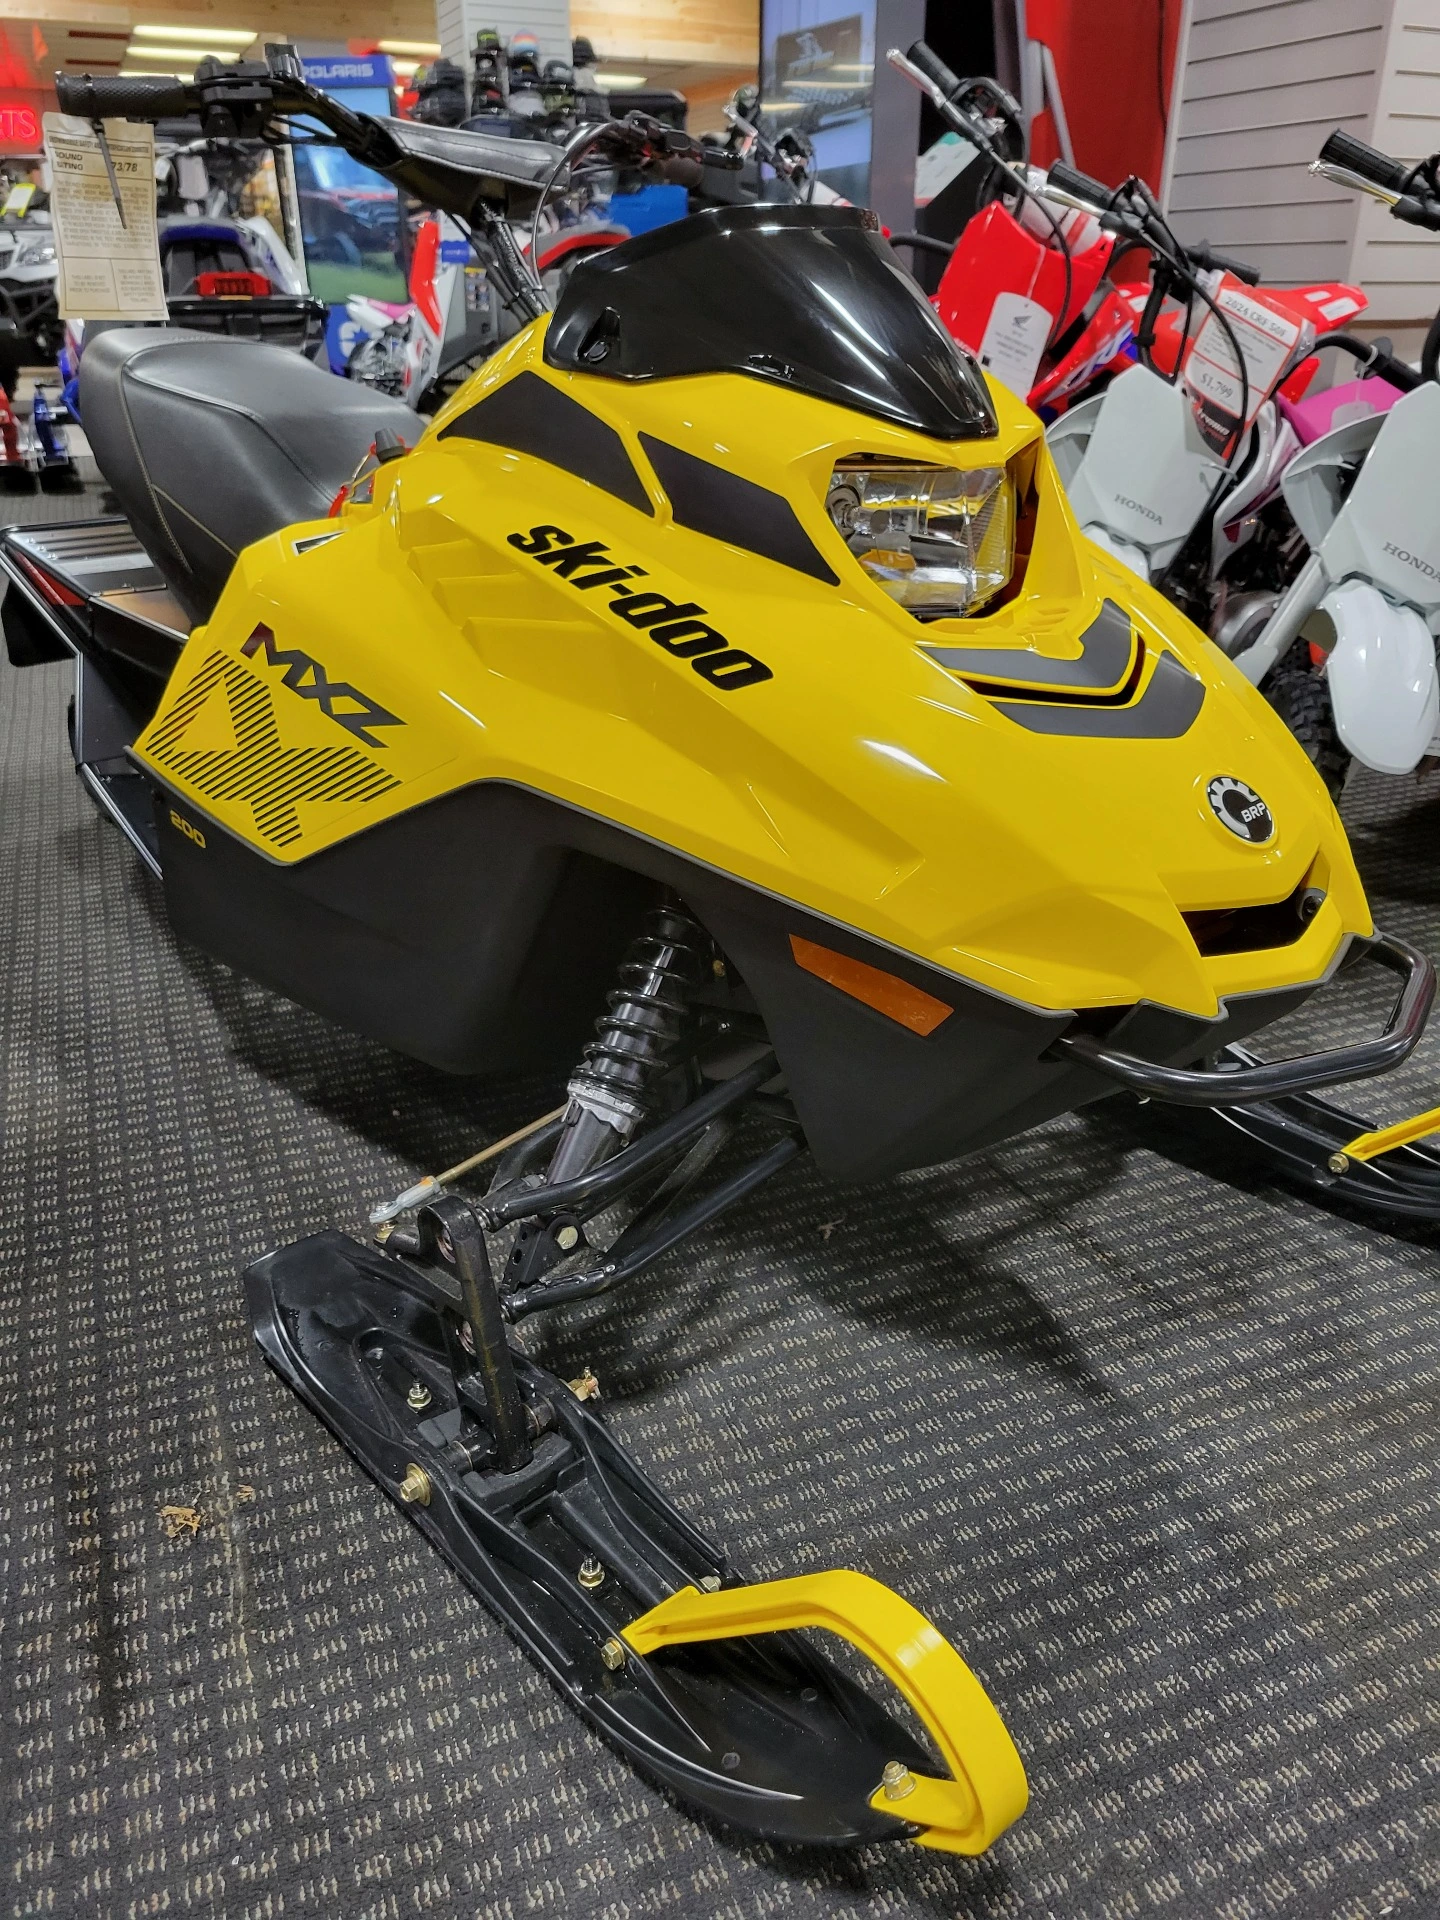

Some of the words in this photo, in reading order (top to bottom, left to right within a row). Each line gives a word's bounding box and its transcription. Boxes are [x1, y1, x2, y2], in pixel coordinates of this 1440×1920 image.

[303, 63, 374, 79] POLARIS
[1114, 493, 1163, 525] HONDA
[506, 525, 774, 691] ski-doo
[240, 621, 408, 749] MXZ
[169, 809, 207, 849] 200
[1240, 802, 1266, 823] BRP
